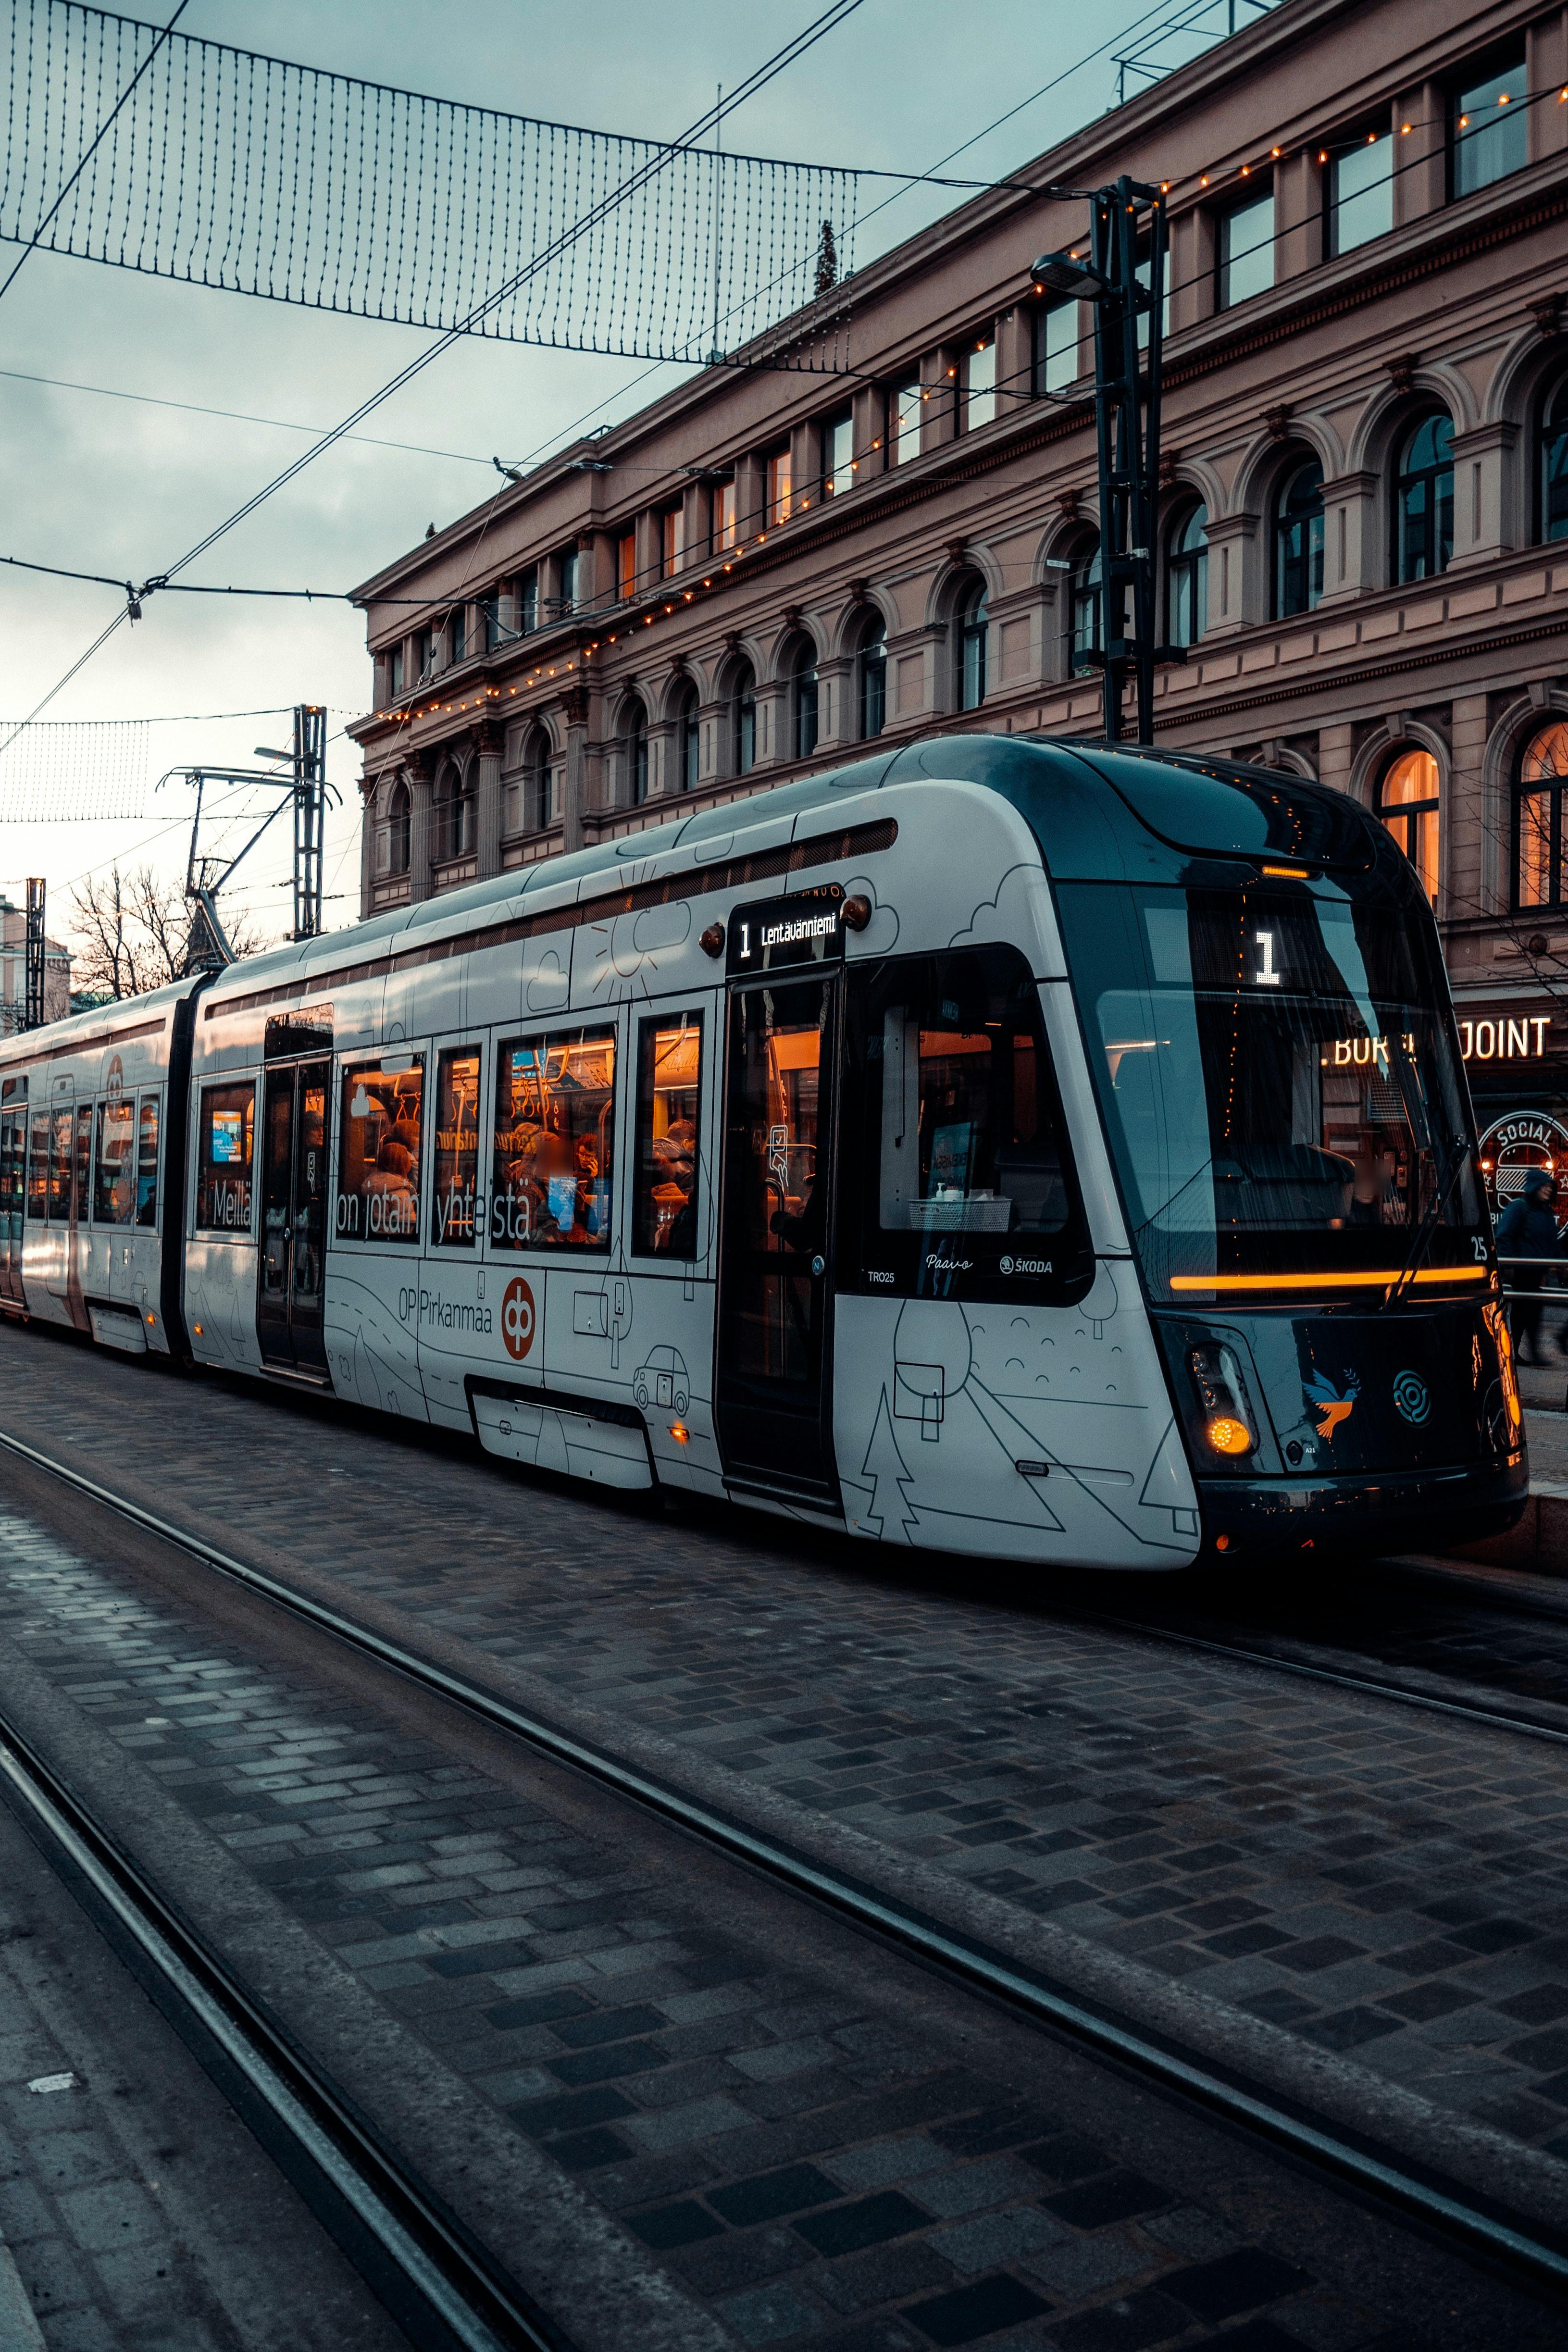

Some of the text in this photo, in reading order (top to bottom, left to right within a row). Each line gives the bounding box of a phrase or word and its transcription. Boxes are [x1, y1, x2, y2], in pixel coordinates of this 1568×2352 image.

[741, 913, 836, 958] 1 Lentävänniemi
[1256, 932, 1280, 984] 1
[1461, 1017, 1551, 1061] JOINT
[1497, 1121, 1552, 1147] SOCIAL
[213, 1177, 530, 1244] Meillä on jotain yhteistä
[926, 1254, 973, 1269] Paavo
[1015, 1258, 1052, 1273] ŠKODA
[1471, 1236, 1487, 1261] 25
[399, 1287, 492, 1334] OP Pirkanmaa
